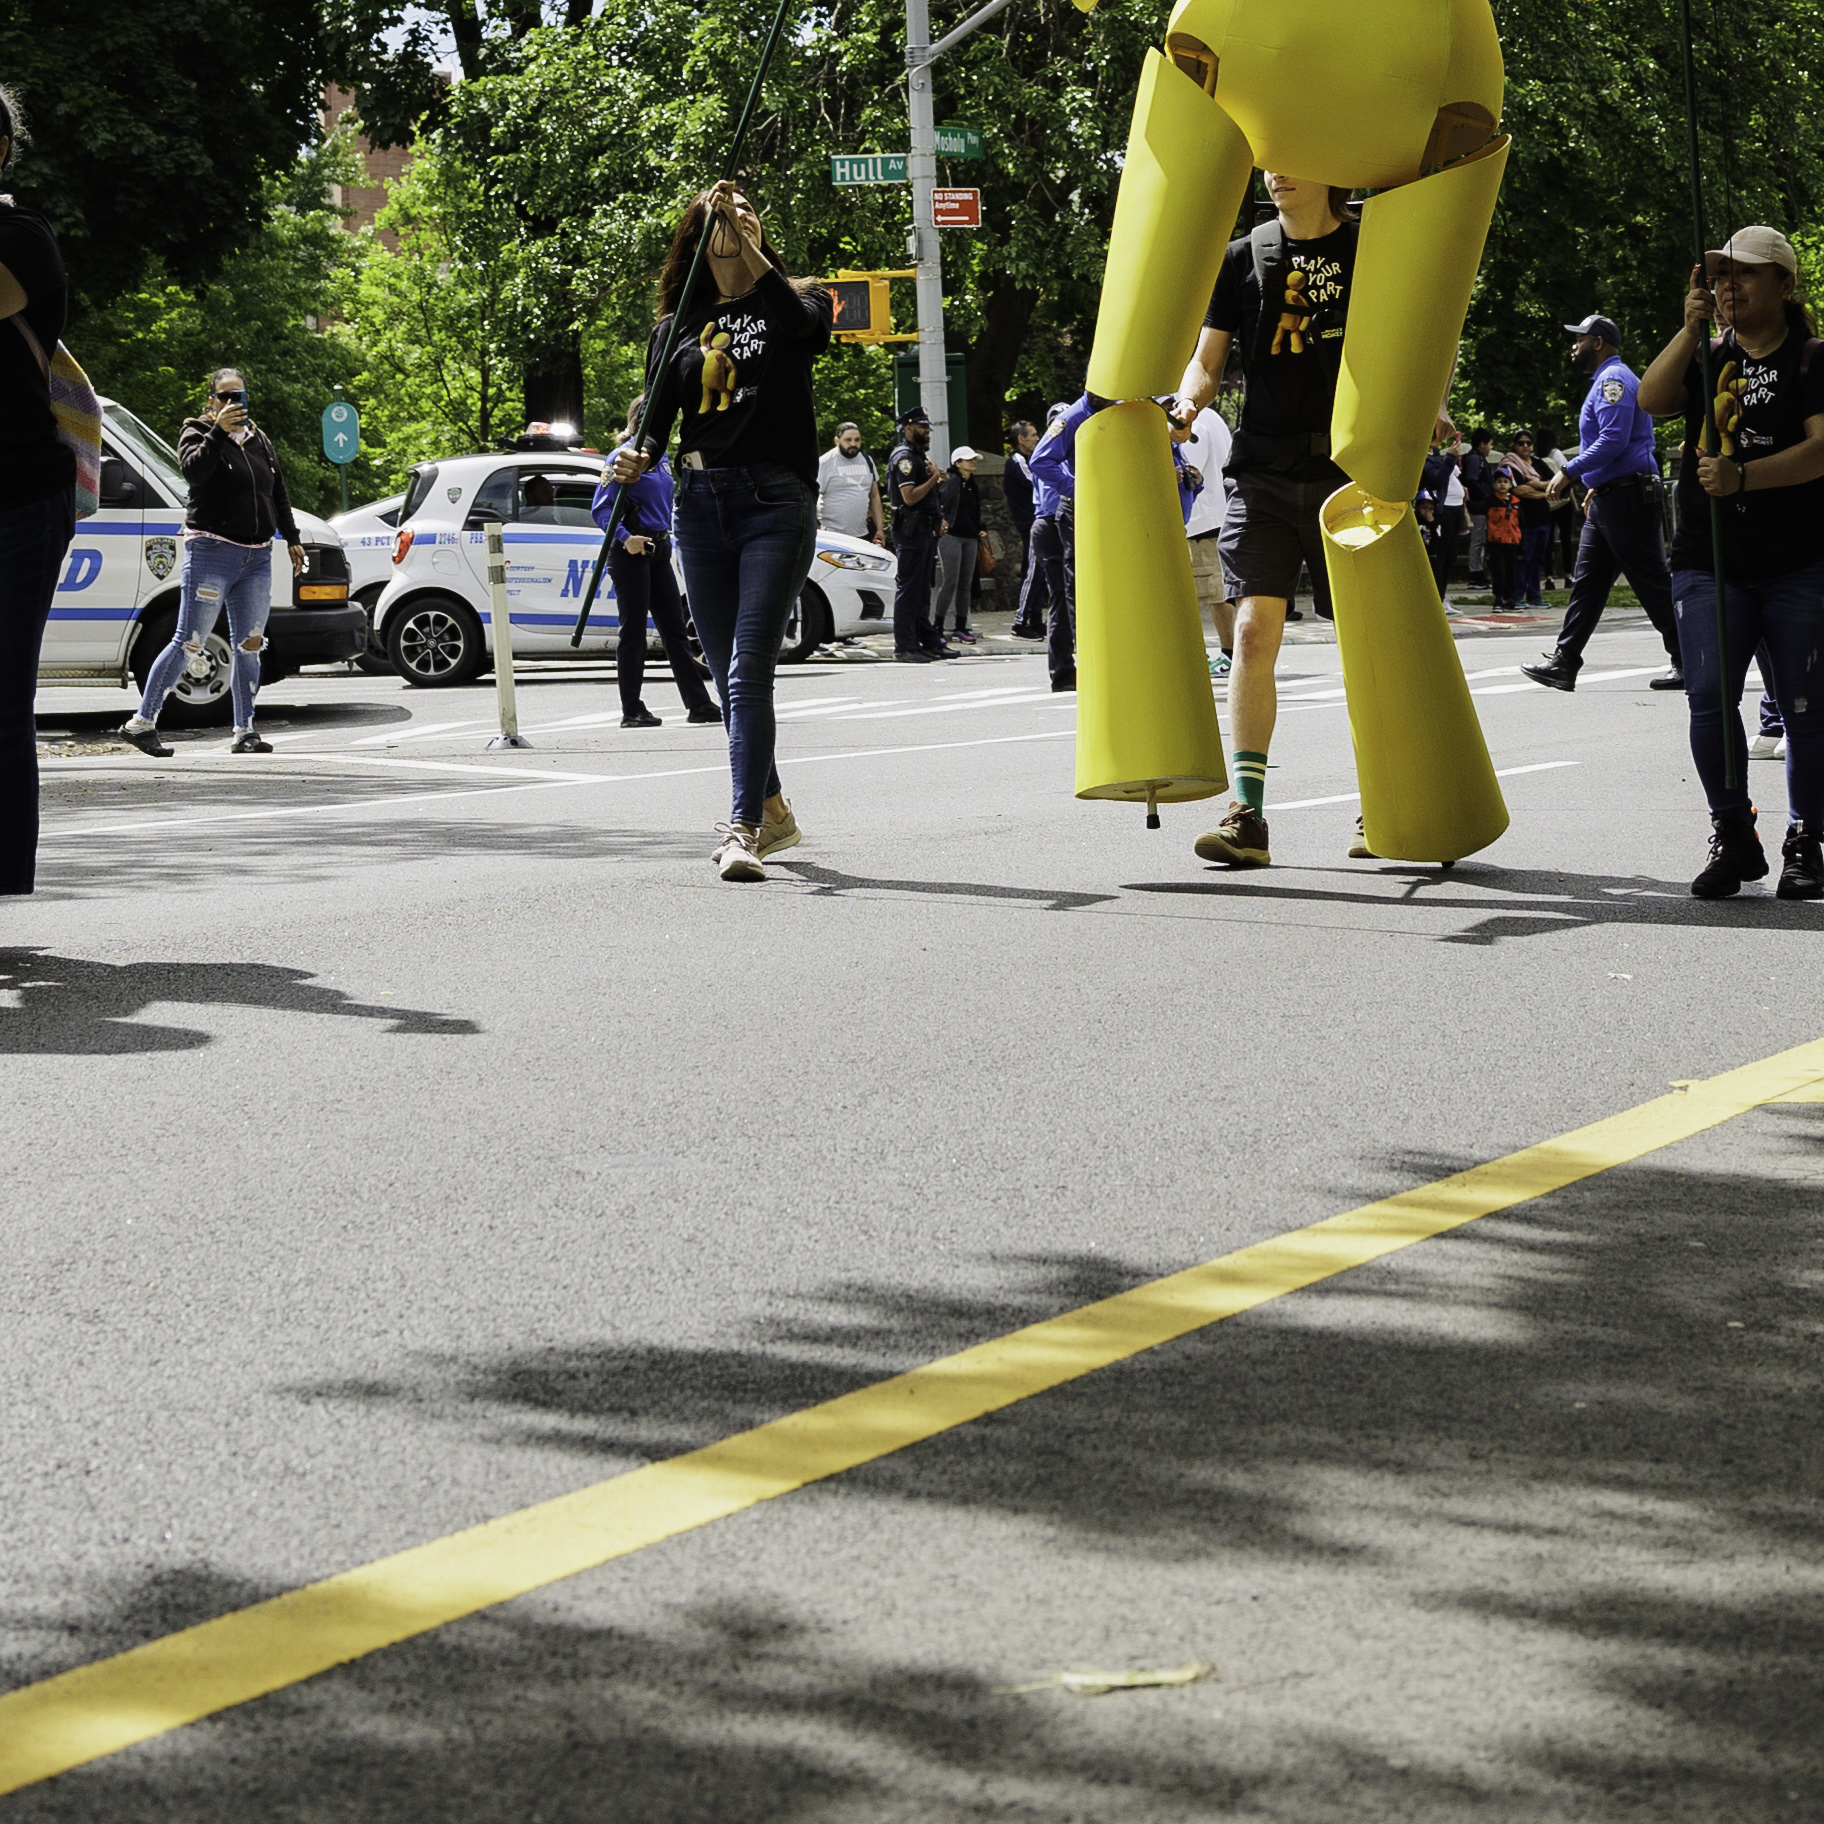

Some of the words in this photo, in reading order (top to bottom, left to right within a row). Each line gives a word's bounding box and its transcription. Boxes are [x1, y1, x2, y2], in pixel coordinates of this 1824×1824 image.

[935, 131, 965, 153] Mosholu
[835, 158, 884, 181] Hull
[888, 159, 904, 170] Av
[934, 192, 943, 200] NO
[944, 192, 973, 200] STANDING
[934, 201, 960, 210] Anytime
[1291, 256, 1325, 272] PLAY
[1308, 262, 1342, 285] YOUR
[1308, 282, 1343, 302] PART
[718, 314, 752, 331] PLAY
[732, 319, 766, 344] YOUR
[732, 339, 766, 359] PART
[1743, 387, 1776, 406] PART
[837, 465, 868, 476] PUMA
[360, 537, 371, 546] 43
[375, 536, 390, 546] PCT
